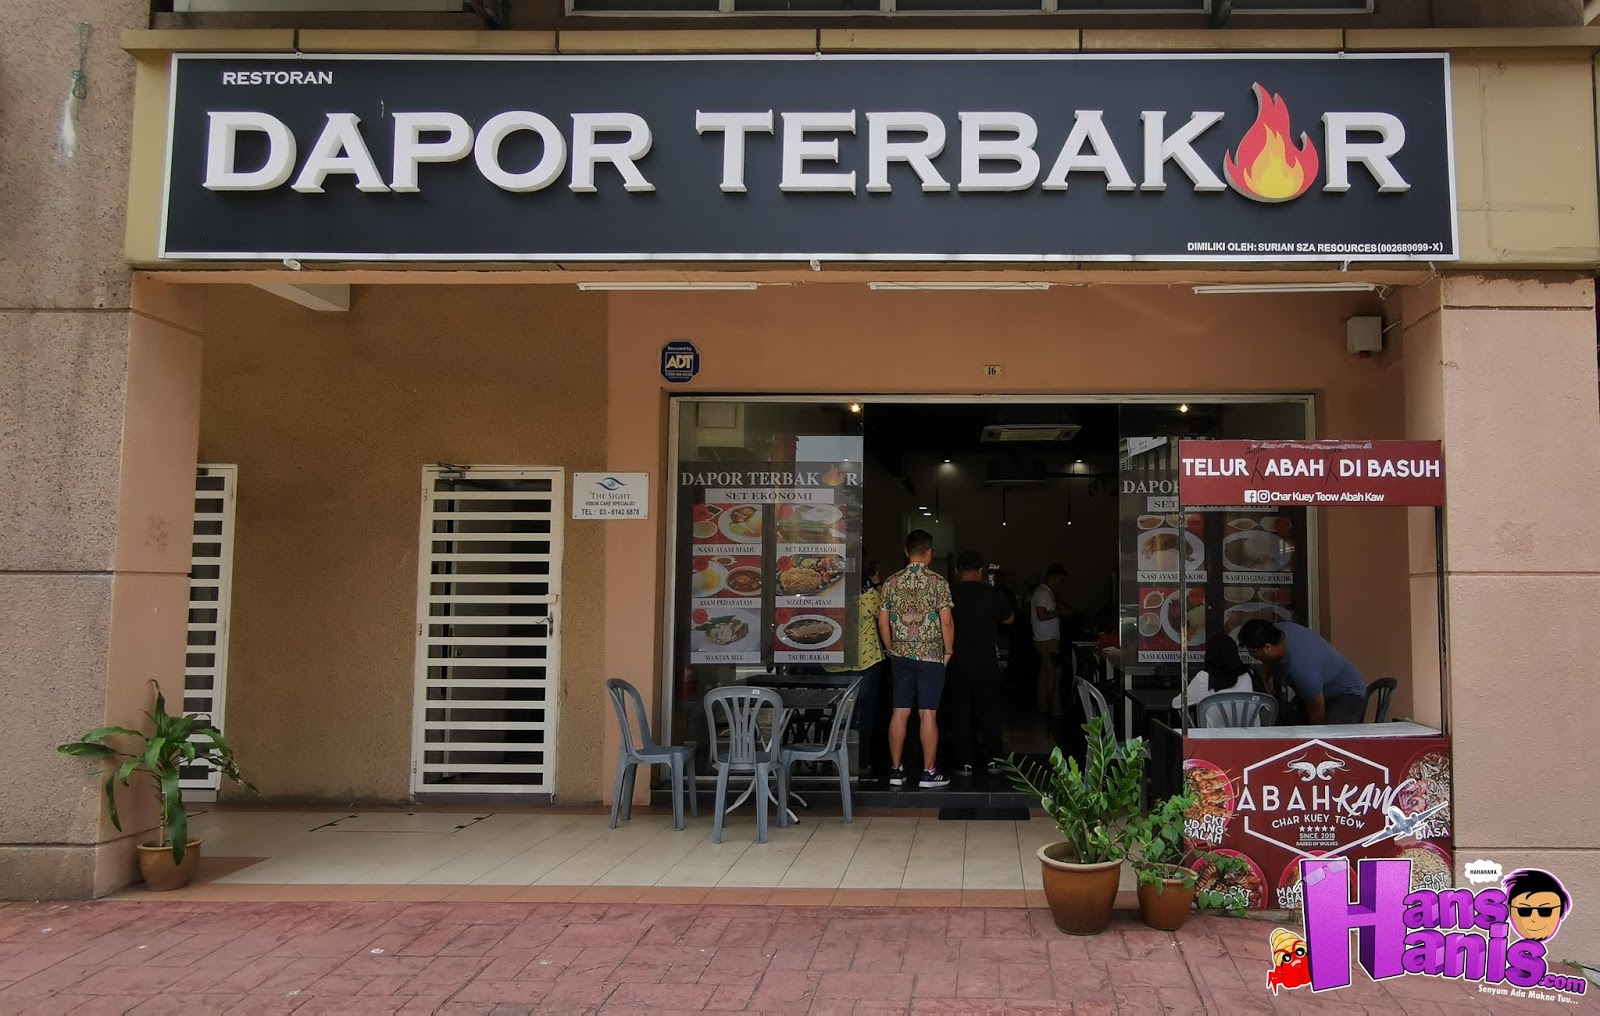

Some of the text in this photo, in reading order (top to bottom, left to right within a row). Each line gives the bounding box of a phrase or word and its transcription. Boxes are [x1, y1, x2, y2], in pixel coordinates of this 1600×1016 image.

[222, 71, 333, 85] RESTORAN
[203, 110, 656, 193] DAPOR
[1187, 242, 1225, 252] DIMILIKI
[1227, 242, 1257, 252] OLEH:
[1258, 243, 1294, 252] SURIAN
[1296, 243, 1316, 252] SZA
[665, 354, 694, 369] ADT
[988, 366, 997, 376] 16
[1182, 458, 1440, 478] TELUR ABAH DI BASUH
[681, 472, 744, 486] DAPOR
[725, 492, 812, 500] SET EKONOMI
[1270, 491, 1385, 504] Char Kuey Teow Abah Kaw
[1153, 500, 1178, 508] SET
[1184, 818, 1224, 835] UDANG
[1203, 813, 1226, 827] CKT
[1271, 814, 1365, 830] CHAR KUEY TEOW
[1184, 827, 1223, 844] GALAH
[1415, 826, 1449, 840] BIASA
[1423, 872, 1445, 885] CKT
[1229, 885, 1252, 899] CKT
